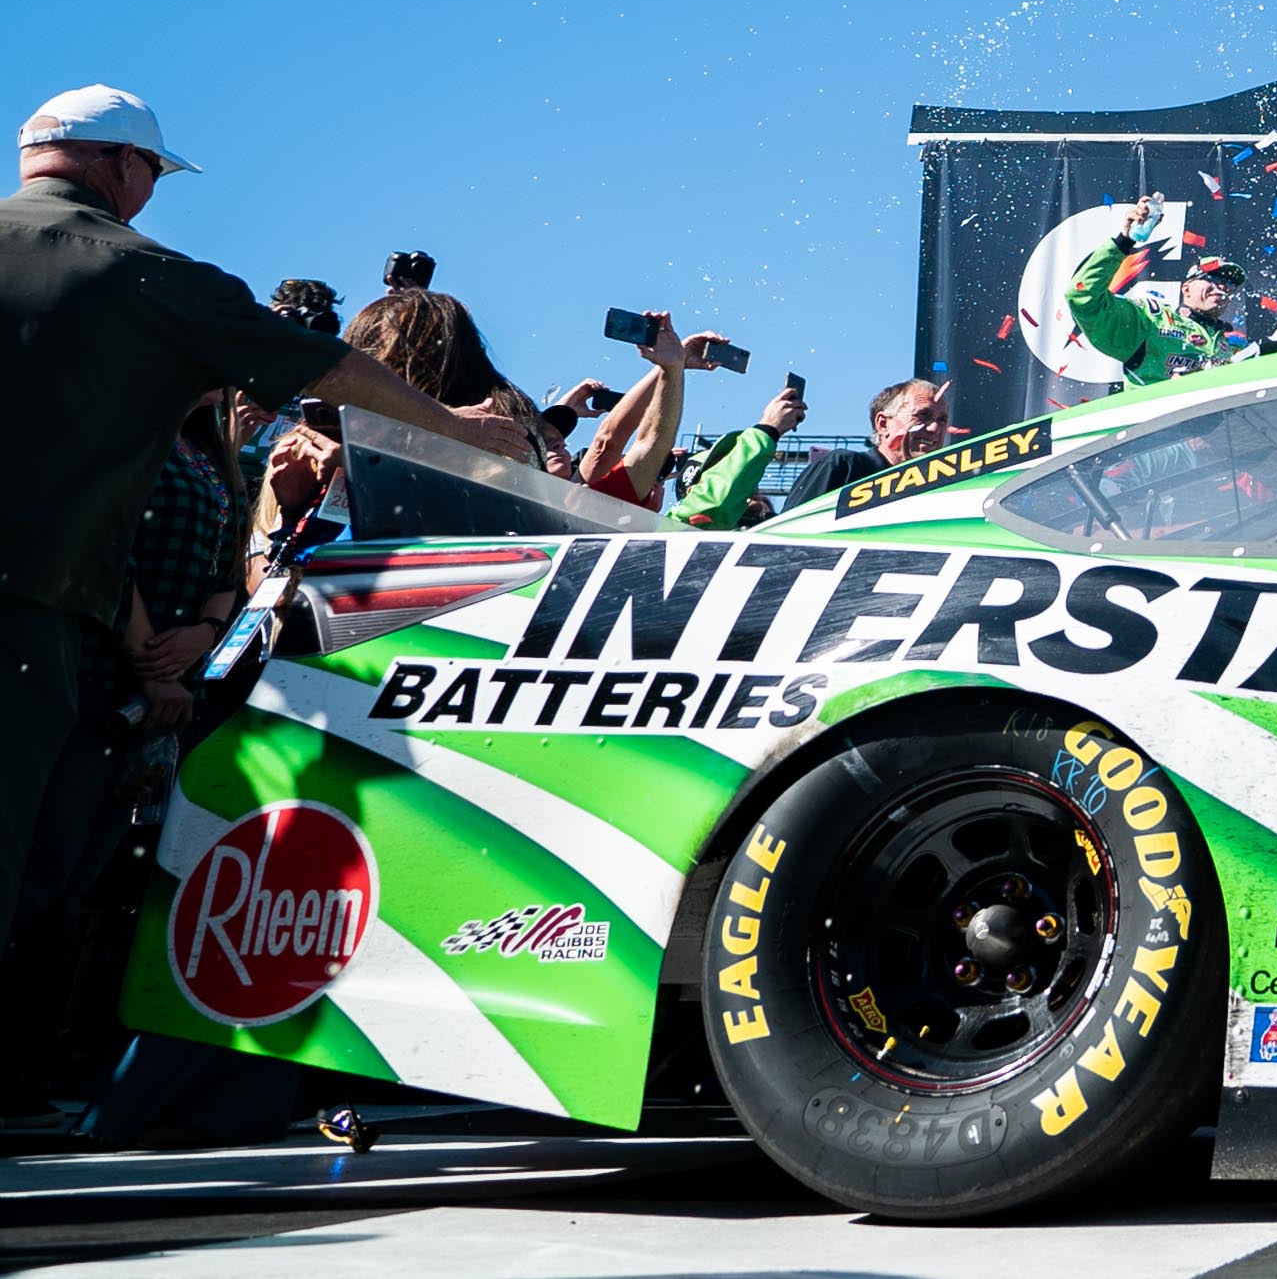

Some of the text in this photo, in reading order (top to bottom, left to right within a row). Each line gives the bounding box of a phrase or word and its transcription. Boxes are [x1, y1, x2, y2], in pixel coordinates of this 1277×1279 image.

[368, 662, 833, 730] BATTERIES
[185, 811, 363, 986] Rheem
[555, 937, 605, 947] GIBBS
[573, 924, 607, 935] JOE
[719, 824, 786, 1046] EAGLE
[541, 949, 604, 960] RACING
[857, 997, 882, 1027] AERO
